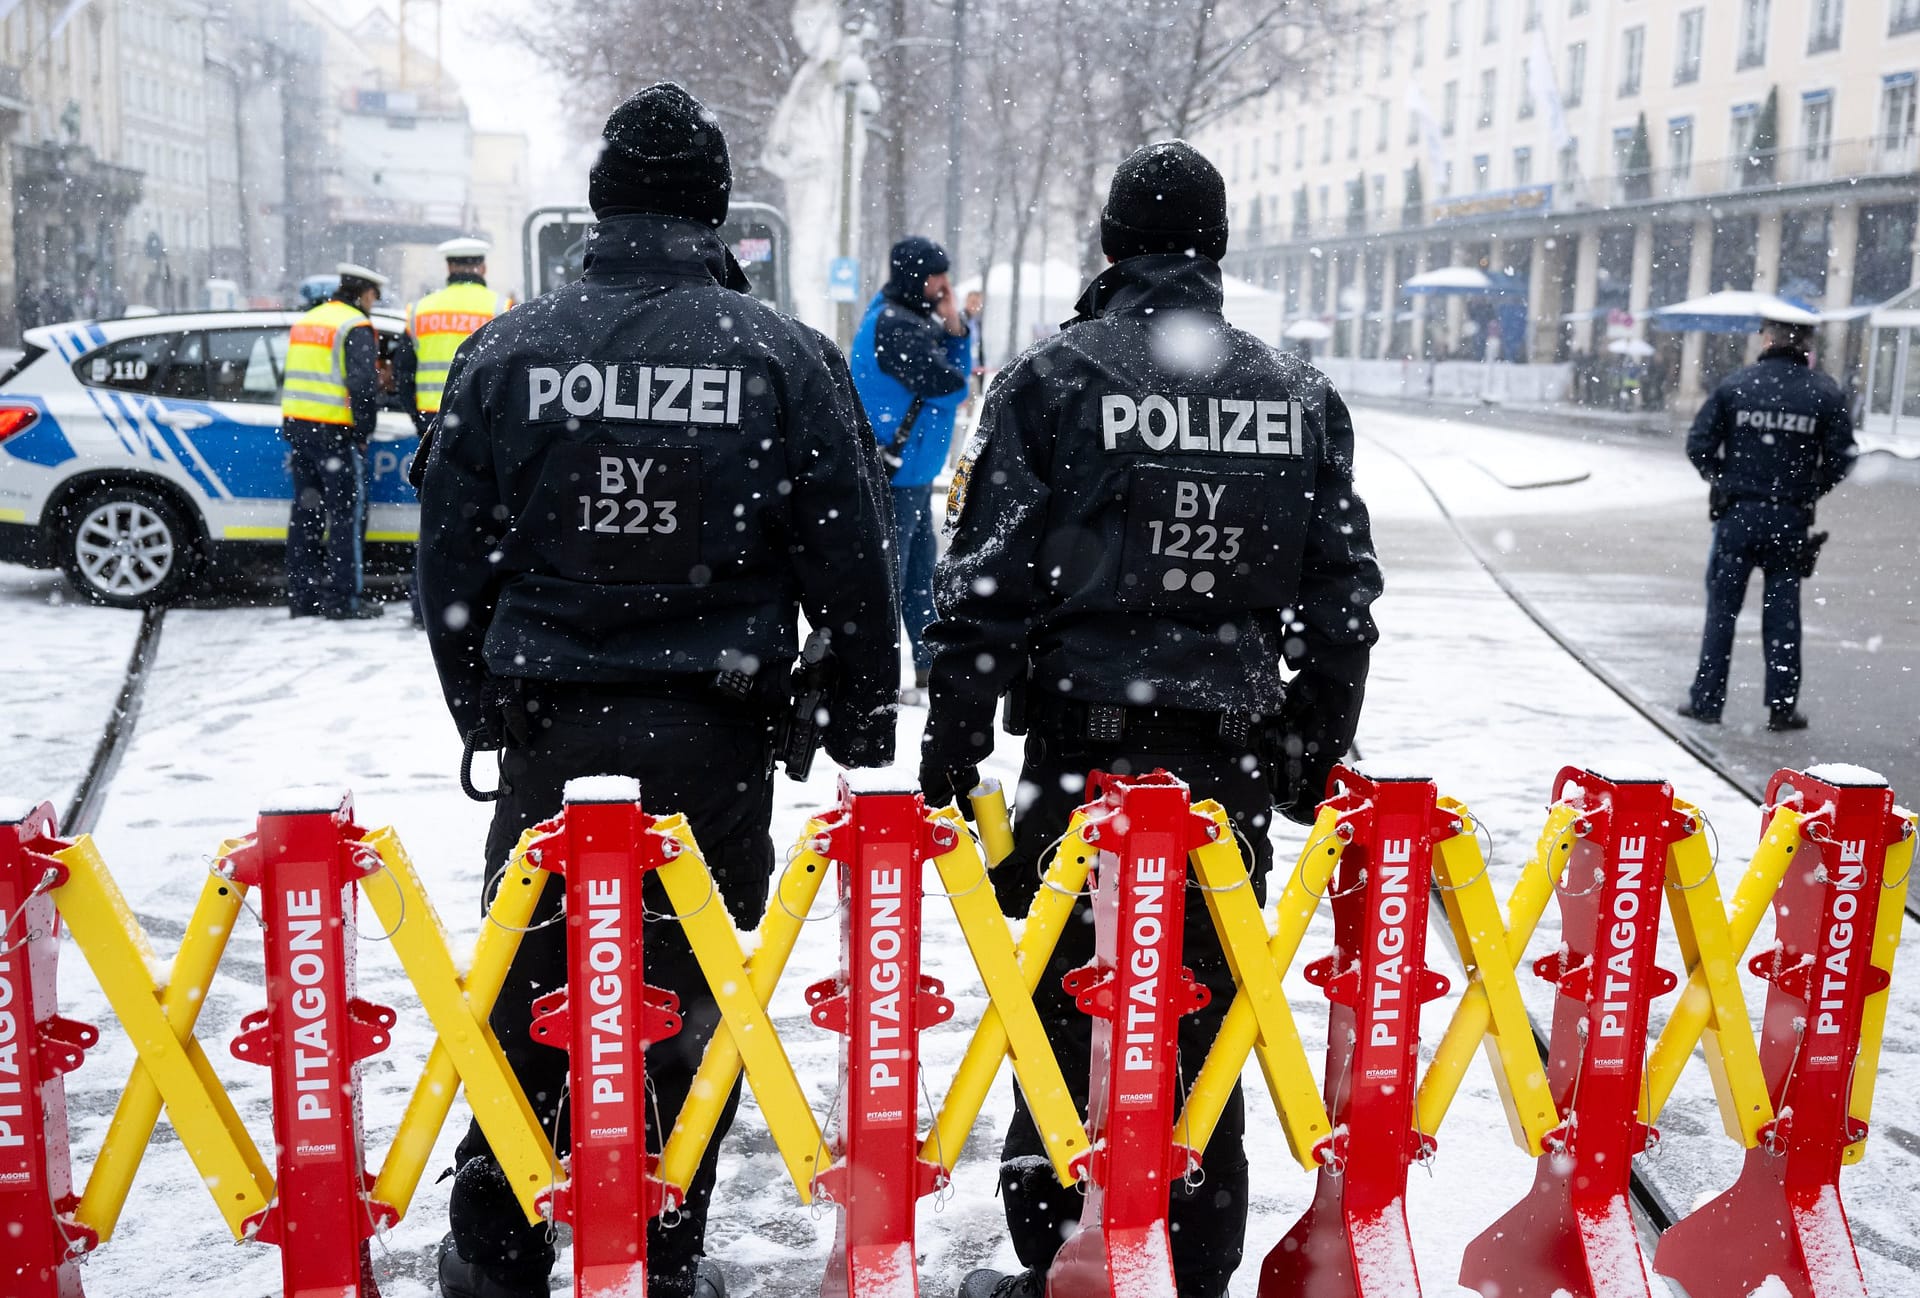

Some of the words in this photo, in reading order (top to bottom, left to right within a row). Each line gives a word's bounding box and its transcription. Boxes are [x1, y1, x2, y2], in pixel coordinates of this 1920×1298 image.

[113, 360, 148, 380] 110
[528, 362, 741, 424] POLIZEI
[1101, 394, 1303, 455] POLIZEI
[1736, 410, 1816, 434] POLIZEI
[600, 456, 654, 494] BY
[1175, 480, 1226, 520] BY
[578, 495, 677, 534] 1223
[1149, 520, 1244, 560] 1223
[1124, 857, 1166, 1071] PITAGONE
[1370, 838, 1411, 1047] PITAGONE
[1599, 836, 1646, 1037] PITAGONE
[1816, 839, 1866, 1034] PITAGONE
[287, 889, 331, 1121] PITAGONE
[588, 878, 624, 1104] PITAGONE
[869, 868, 902, 1088] PITAGONE
[296, 1144, 336, 1153] PITAGONE
[591, 1126, 628, 1136] PITAGONE
